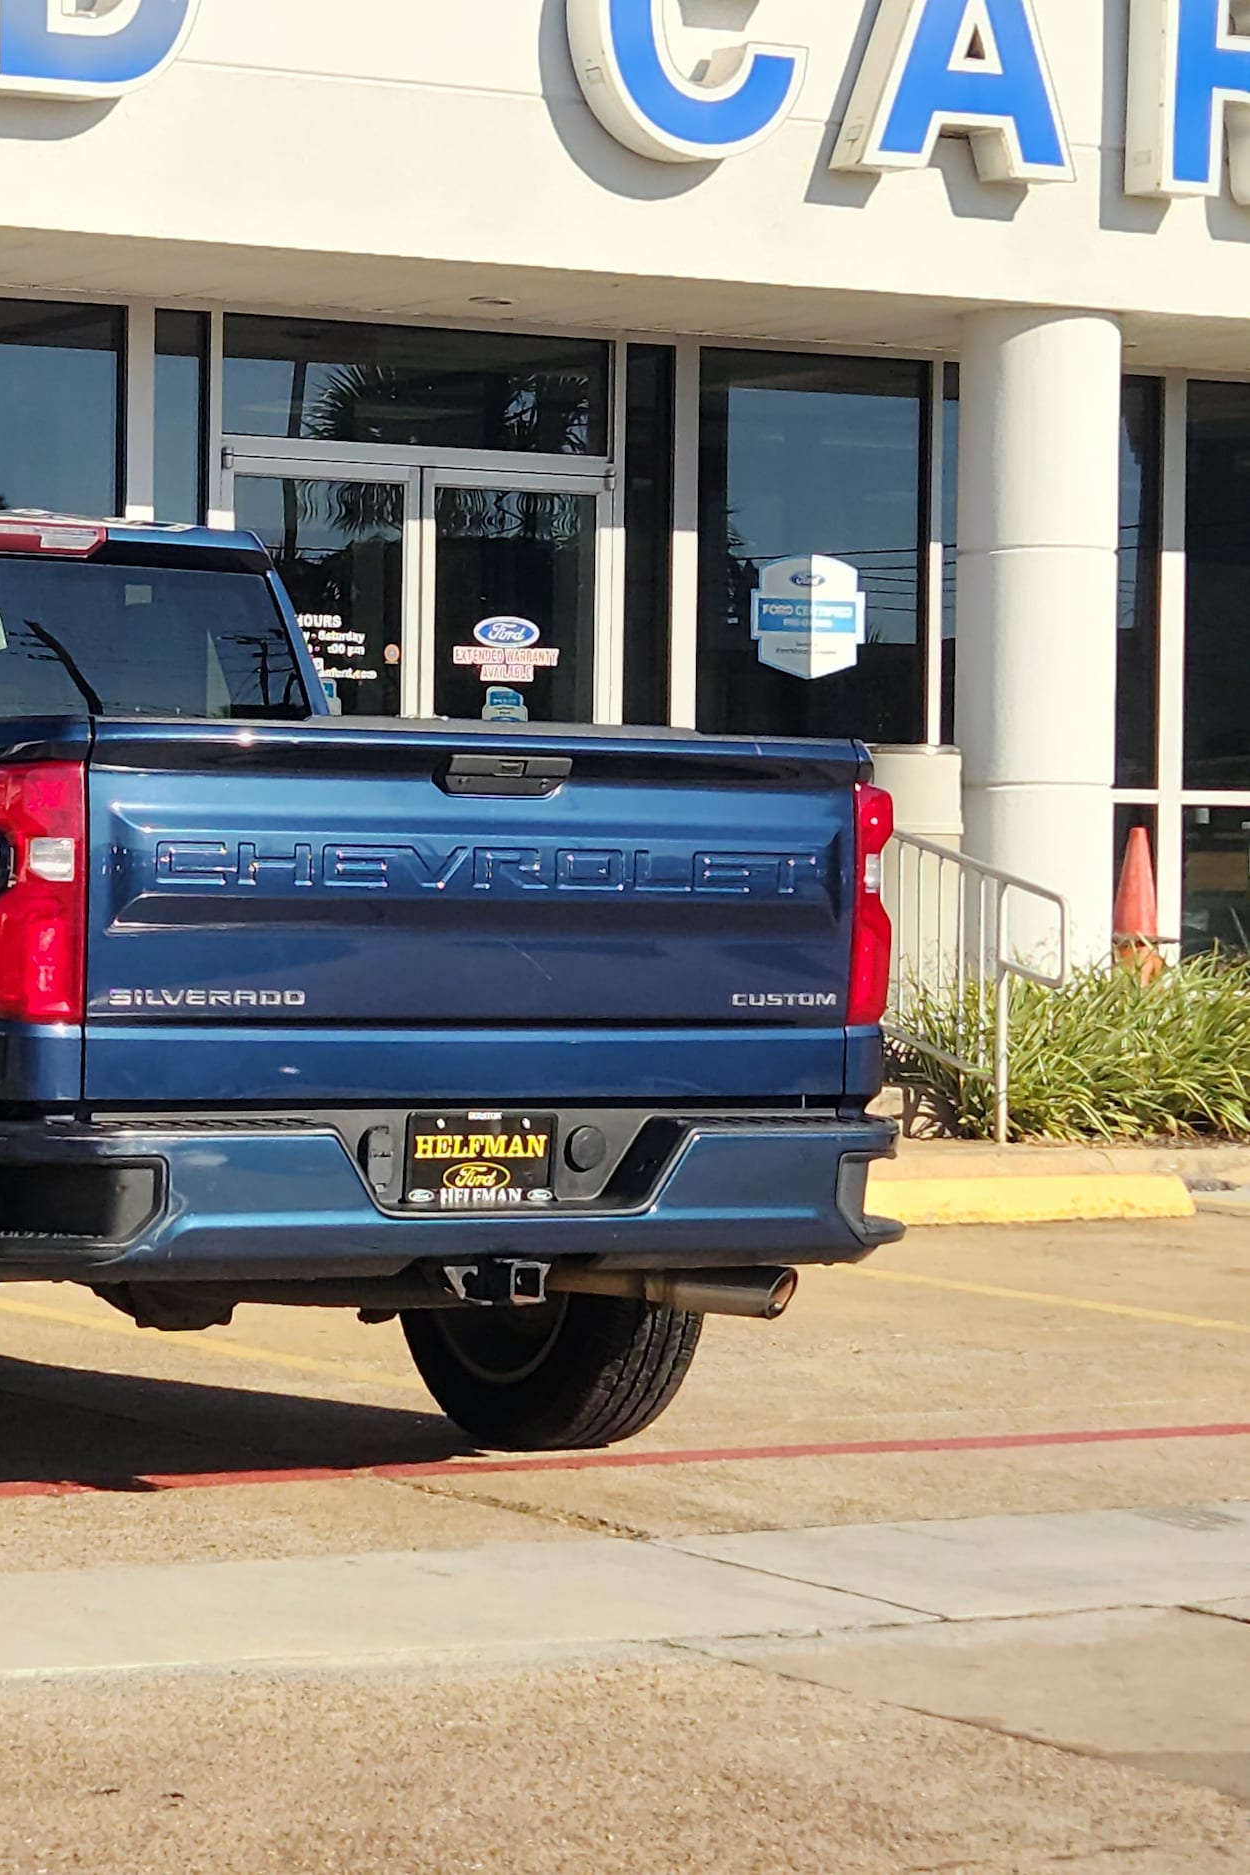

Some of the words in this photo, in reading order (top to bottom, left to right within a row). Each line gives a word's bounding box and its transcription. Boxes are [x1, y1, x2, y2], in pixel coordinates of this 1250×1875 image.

[487, 622, 526, 641] Ford
[454, 647, 505, 664] EXTENDED
[506, 649, 558, 665] WARRANTY
[154, 839, 817, 895] CHEVROLET
[108, 988, 306, 1007] SILVERADO
[732, 993, 837, 1006] CUSTOM
[414, 1134, 548, 1159] HELFMAN
[455, 1166, 498, 1187] Ford
